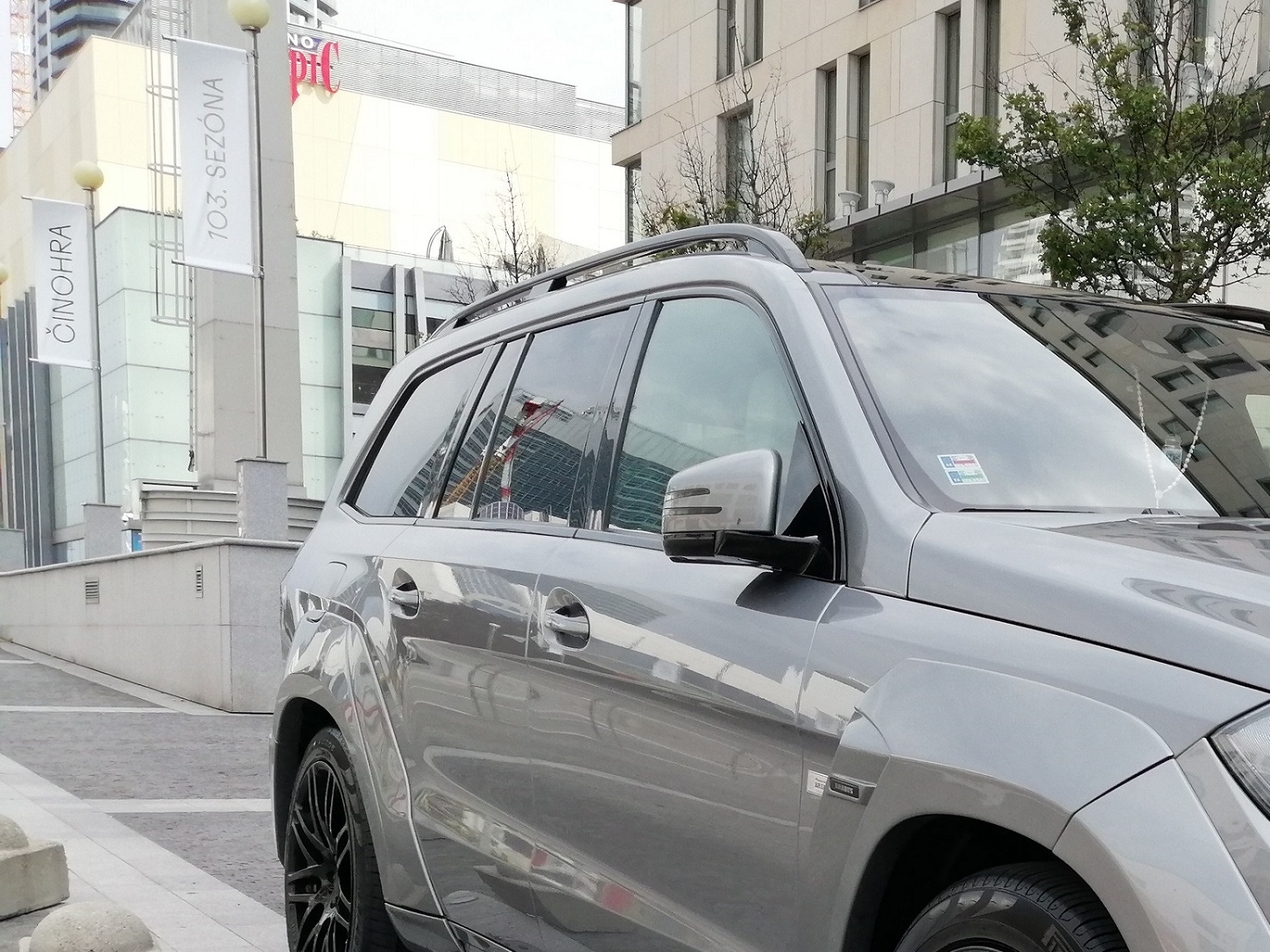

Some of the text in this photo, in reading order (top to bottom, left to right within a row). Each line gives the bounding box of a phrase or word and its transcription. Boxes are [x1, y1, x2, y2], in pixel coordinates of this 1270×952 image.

[197, 78, 228, 240] 103. SEZÓNA
[46, 225, 76, 343] ČINOHRA
